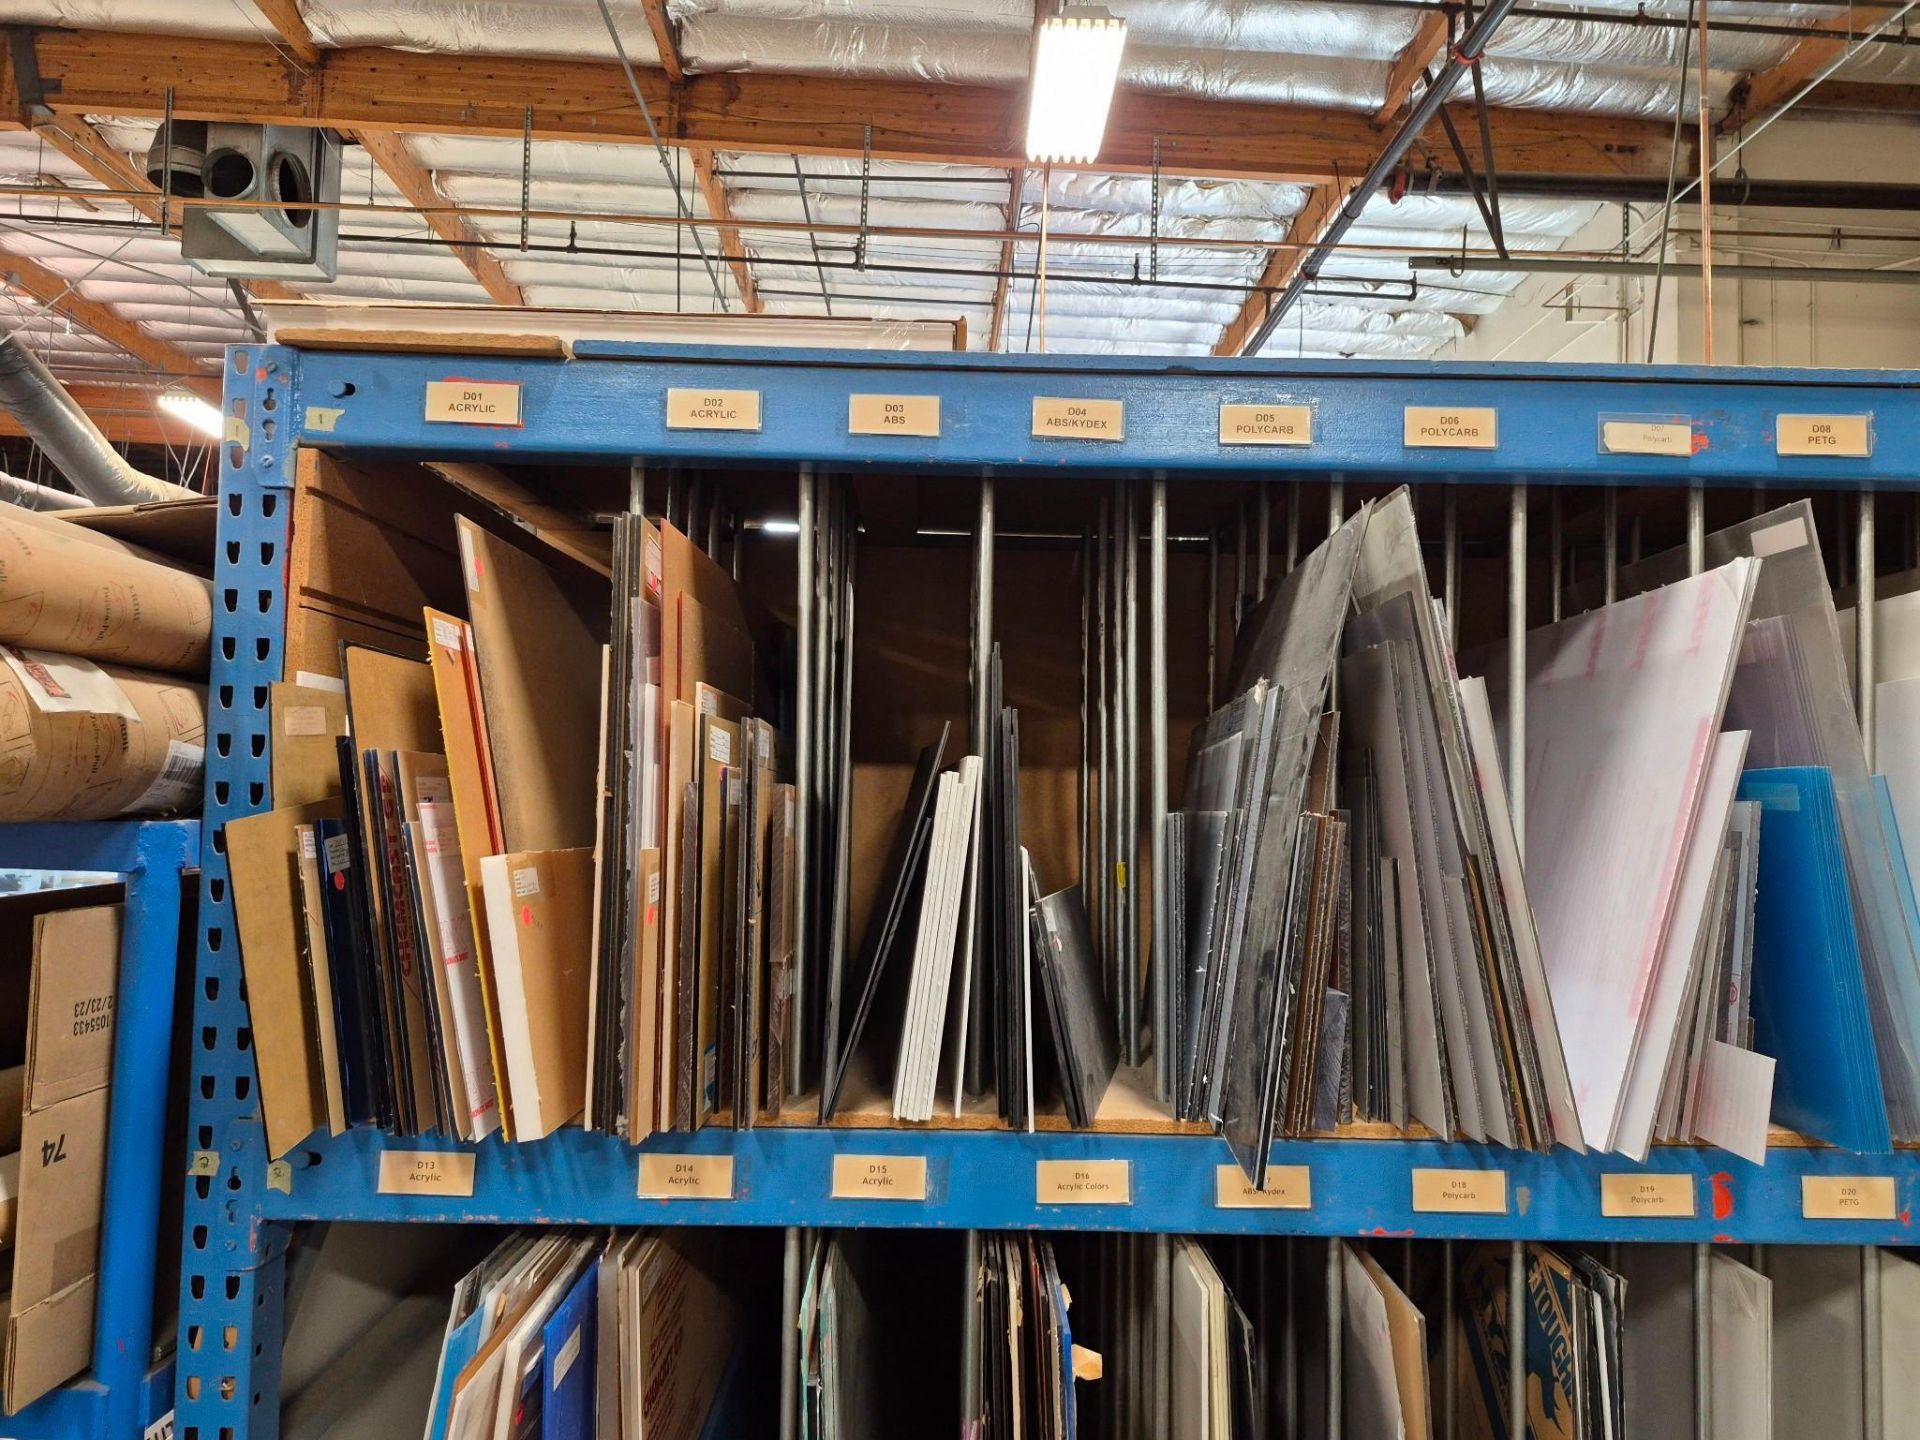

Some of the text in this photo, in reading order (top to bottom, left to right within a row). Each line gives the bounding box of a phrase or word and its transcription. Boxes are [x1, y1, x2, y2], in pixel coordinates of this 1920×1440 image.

[463, 391, 483, 401] D01
[448, 402, 496, 413] ACRYLIC
[703, 398, 723, 408] D02
[884, 403, 904, 413] D03
[690, 407, 738, 418] ACRYLIC
[1067, 407, 1087, 417] D04
[883, 415, 906, 425] ABS
[1255, 413, 1275, 423] D05
[1440, 416, 1459, 426] D06
[1046, 418, 1108, 430] ABS/KYDEX
[1812, 424, 1832, 434] D08
[1236, 424, 1294, 435] POLYCARB
[1421, 427, 1479, 437] POLYCARB
[1808, 435, 1836, 445] PETG
[73, 1015, 111, 1037] 1055433
[41, 1133, 67, 1168] 74
[416, 1161, 435, 1171] D13
[675, 1164, 694, 1173] D14
[869, 1165, 887, 1174] D15
[409, 1172, 442, 1183] Acrylic
[668, 1175, 700, 1186] Acrylic
[1074, 1172, 1091, 1180] D16
[862, 1176, 894, 1187] Acrylic
[1451, 1180, 1467, 1189] D18
[1057, 1182, 1109, 1192] Acrylic Colors
[1639, 1185, 1655, 1193] D19
[1841, 1187, 1857, 1196] D20
[1442, 1190, 1476, 1201] Polycarb
[1631, 1195, 1665, 1205] Polycarb
[1838, 1198, 1860, 1206] PETG
